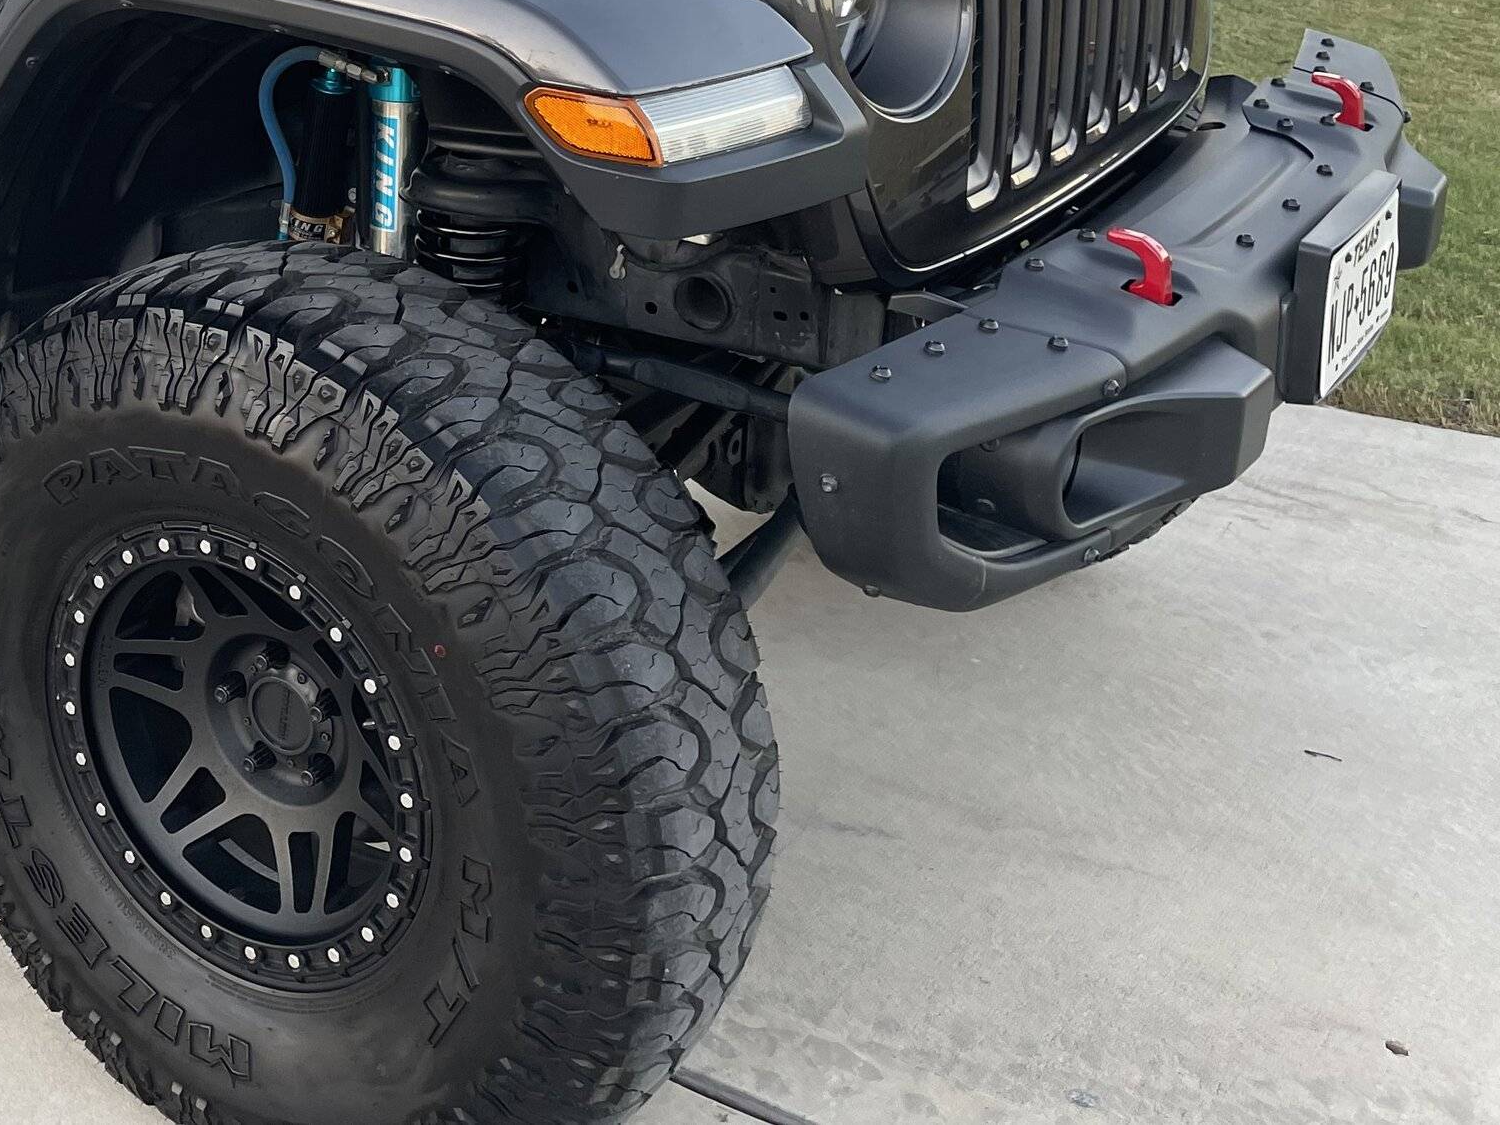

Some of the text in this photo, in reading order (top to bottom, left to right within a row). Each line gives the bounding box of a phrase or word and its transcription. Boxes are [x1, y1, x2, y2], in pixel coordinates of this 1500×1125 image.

[375, 122, 396, 227] KING
[291, 218, 324, 232] ING
[1353, 220, 1381, 267] TEXAS
[44, 446, 481, 807] PATAGONIA
[423, 855, 492, 1049] M/T
